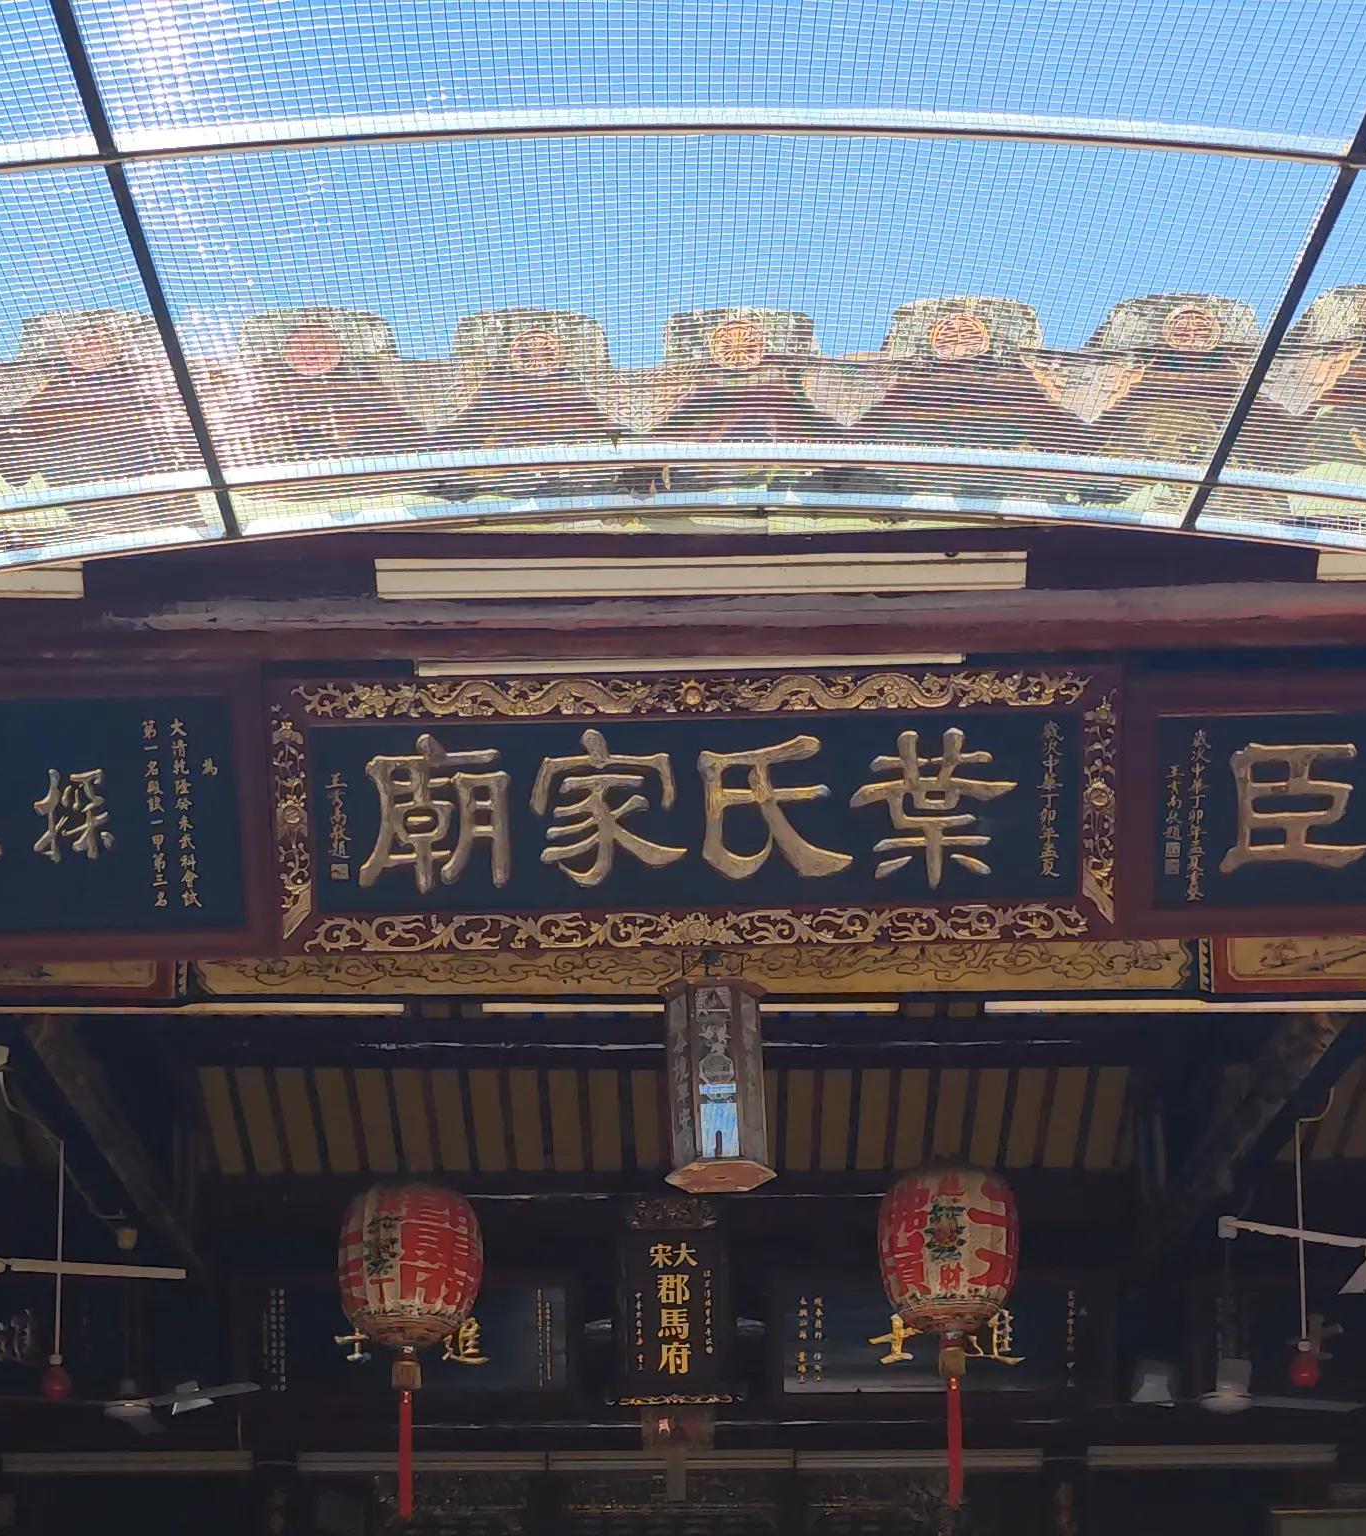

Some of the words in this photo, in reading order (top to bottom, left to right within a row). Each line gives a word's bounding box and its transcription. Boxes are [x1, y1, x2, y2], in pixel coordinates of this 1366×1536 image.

[357, 727, 1018, 893] 葉氏家廟
[656, 1273, 692, 1376] 郡馬府
